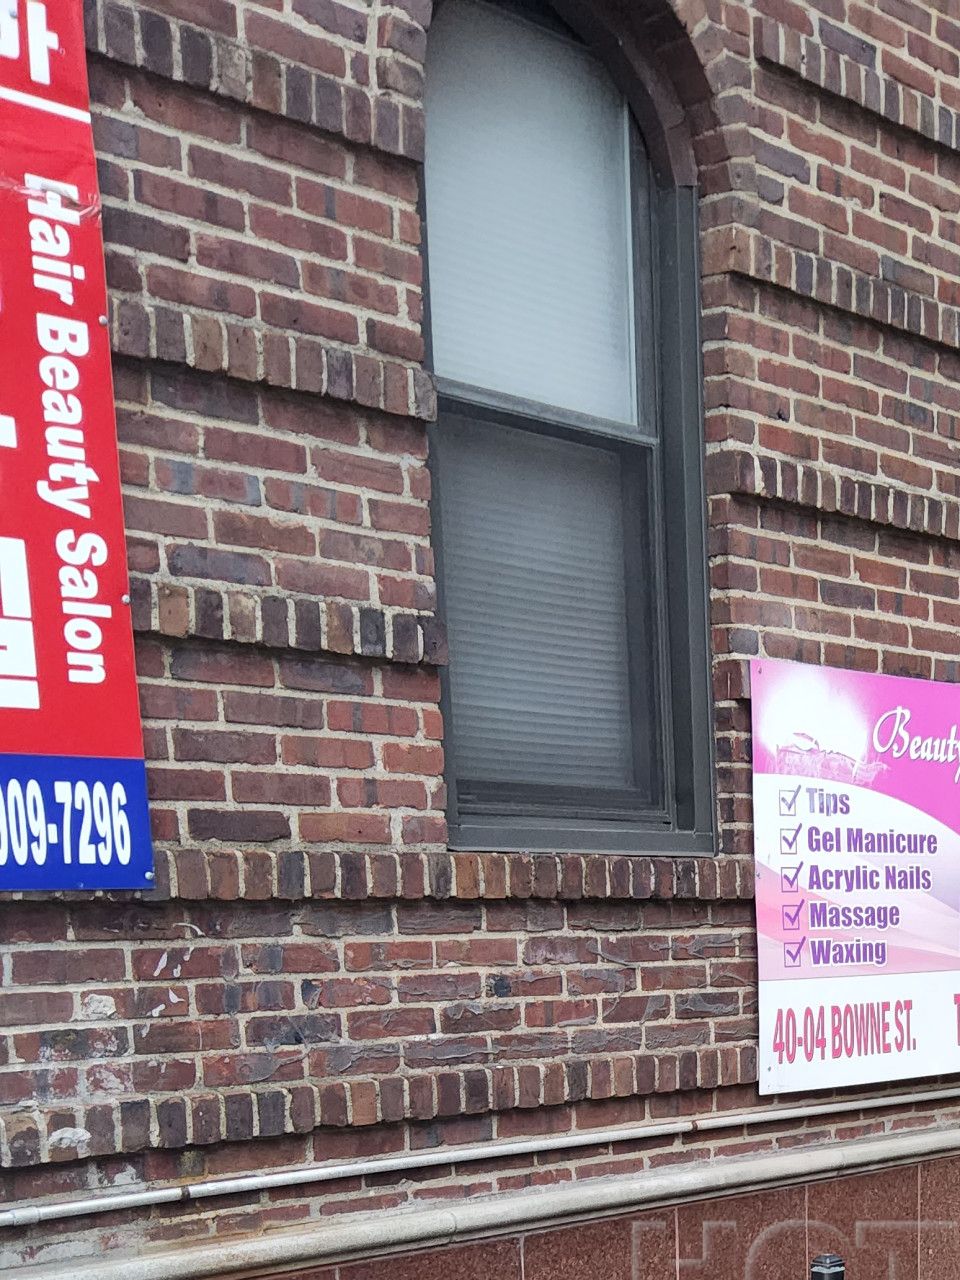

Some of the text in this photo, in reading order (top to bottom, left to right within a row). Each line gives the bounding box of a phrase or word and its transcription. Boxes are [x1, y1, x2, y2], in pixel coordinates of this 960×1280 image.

[24, 173, 112, 684] Hair Beauty Salon
[806, 787, 850, 816] Tips
[807, 826, 938, 854] Gel Manicure
[808, 865, 932, 892] Acrylic Nails
[810, 902, 900, 929] Massage
[810, 938, 887, 965] Waxing
[772, 999, 917, 1065] 40-04 BOWNE ST.
